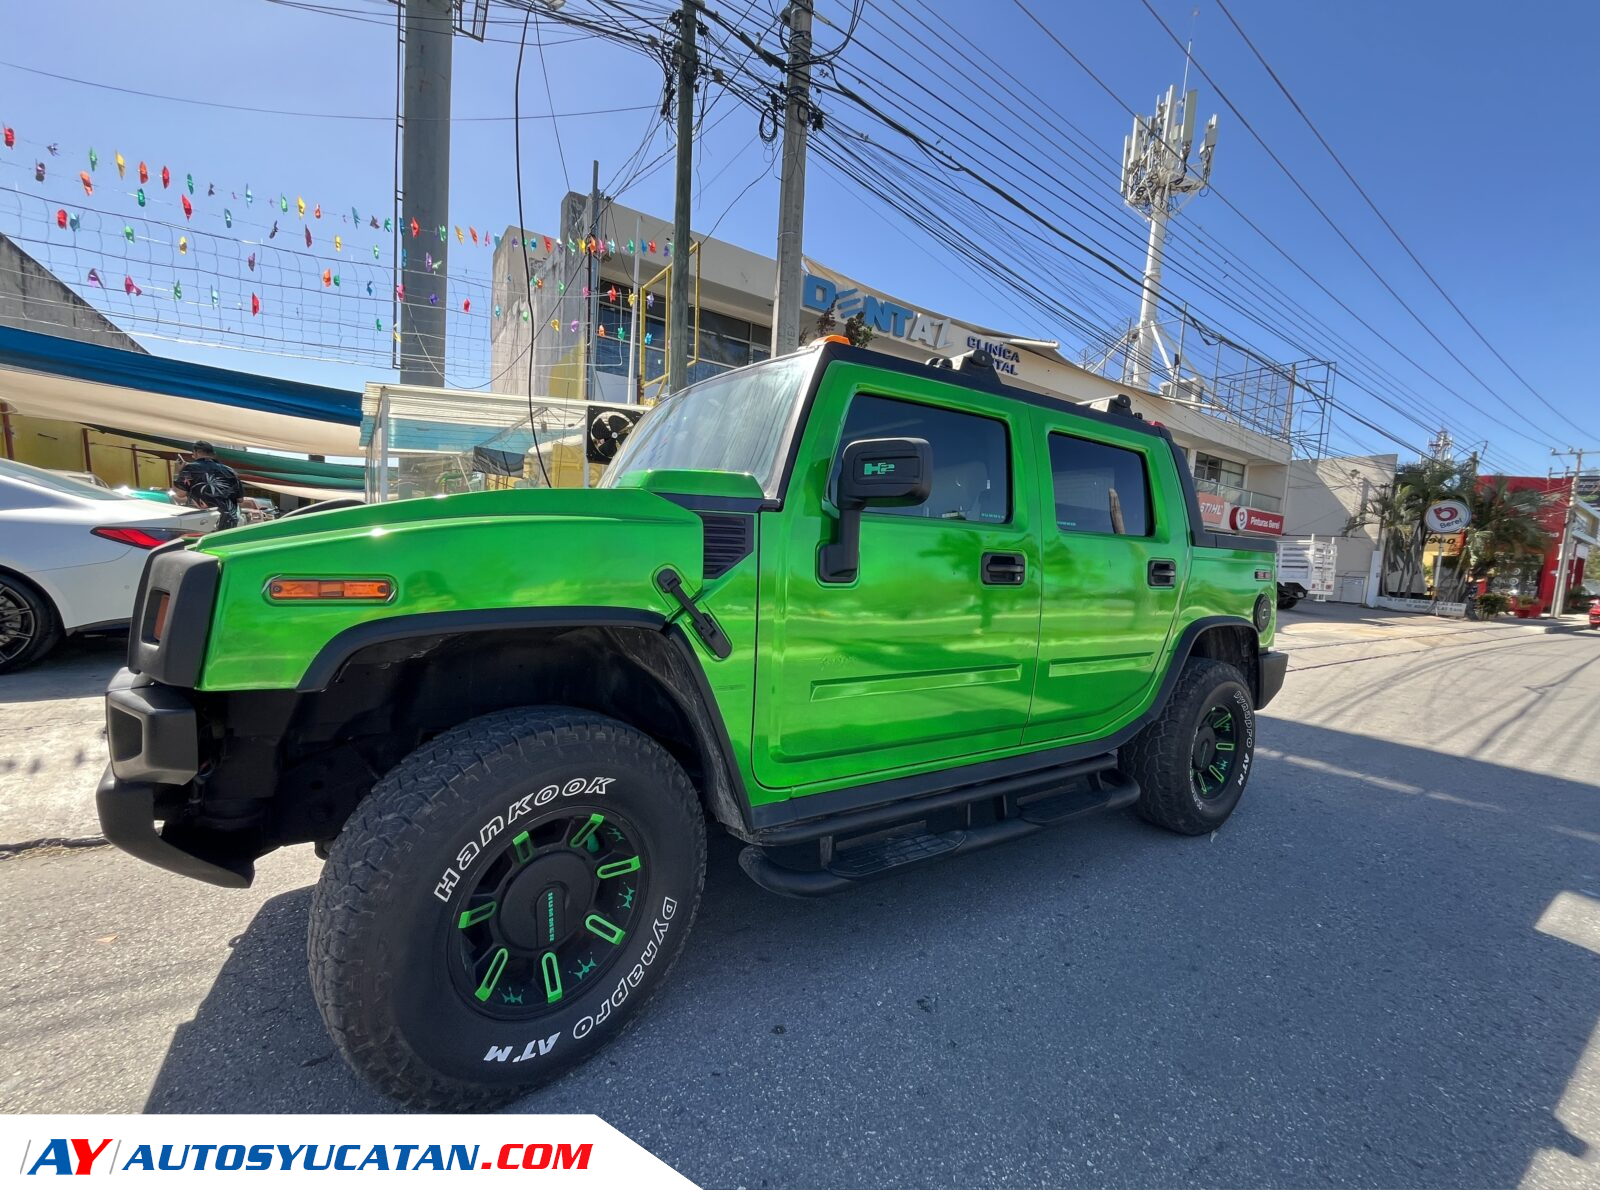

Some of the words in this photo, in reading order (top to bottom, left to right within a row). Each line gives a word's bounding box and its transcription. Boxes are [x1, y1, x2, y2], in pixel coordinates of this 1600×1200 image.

[803, 272, 953, 350] DENTAL
[992, 359, 1019, 376] TAL
[1200, 502, 1223, 515] STIHL
[1250, 516, 1268, 527] Pinturas
[1440, 517, 1463, 529] Berel
